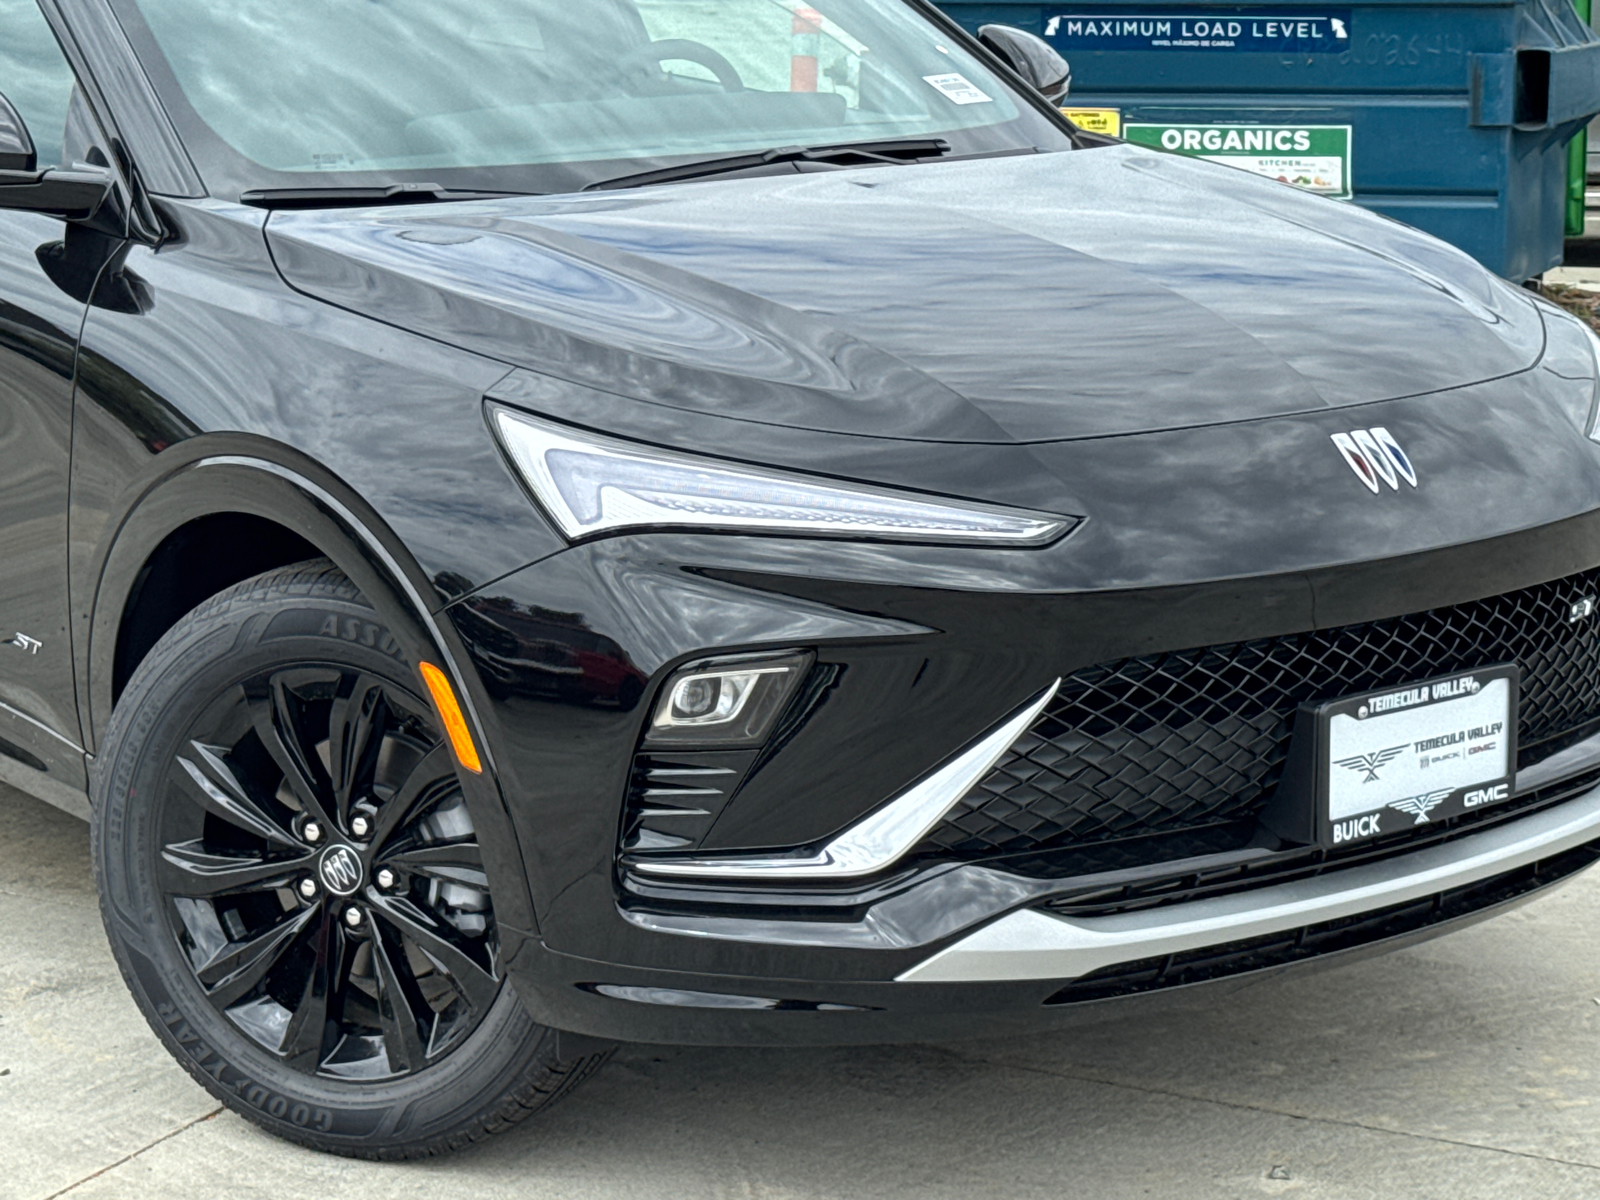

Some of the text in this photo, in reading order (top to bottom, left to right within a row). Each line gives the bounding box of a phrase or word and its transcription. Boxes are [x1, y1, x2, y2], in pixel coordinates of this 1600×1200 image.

[1067, 21, 1324, 39] MAXIMUM LOAD LEVEL
[1160, 129, 1311, 151] ORGANICS
[1258, 159, 1302, 167] KITCHEN
[1367, 676, 1475, 713] TEMECULA VALLEY
[1413, 721, 1503, 753] TEMECULA VALLEY
[1431, 741, 1497, 764] BUICK GMC
[1463, 783, 1509, 808] GMC
[1332, 813, 1381, 843] BUICK
[154, 1001, 334, 1133] GOODYEAR
